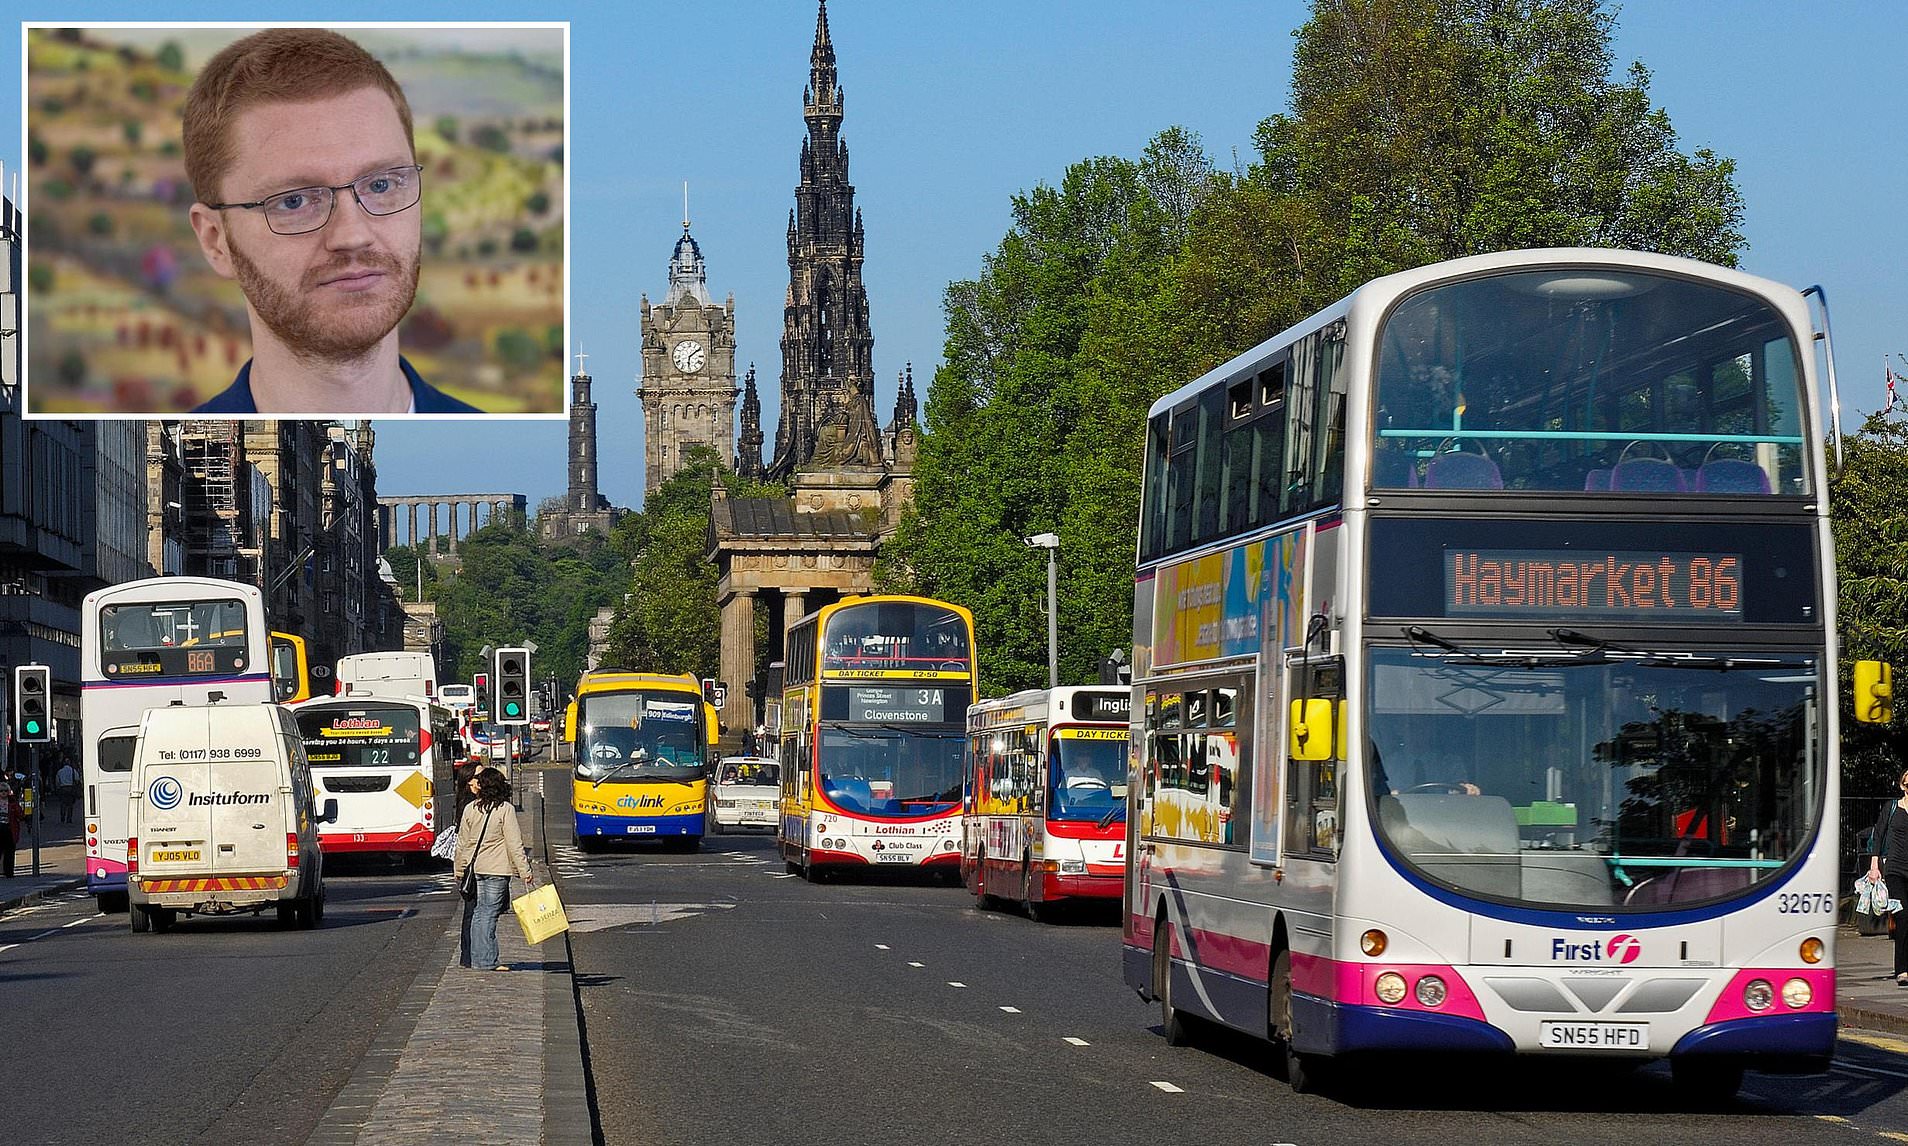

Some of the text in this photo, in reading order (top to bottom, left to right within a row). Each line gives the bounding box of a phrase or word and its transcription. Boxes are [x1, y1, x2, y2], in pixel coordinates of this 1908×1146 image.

[1455, 553, 1738, 609] Haymarket 86
[188, 652, 214, 671] 86A
[648, 710, 692, 722] 909 Edinburgh
[864, 709, 928, 720] Clovenstone
[333, 718, 381, 729] Lothian
[1077, 730, 1097, 738] DAY
[159, 748, 261, 760] Tel: (0117) 938 6999
[372, 750, 388, 764] 22
[188, 791, 270, 806] Insituform
[823, 815, 838, 823] 720
[875, 825, 915, 835] Lothian
[888, 842, 904, 850] Club
[158, 852, 181, 861] YJ05
[1778, 893, 1833, 914] 32676
[1551, 938, 1601, 960] First
[1552, 1027, 1639, 1046] SN55 HFD
